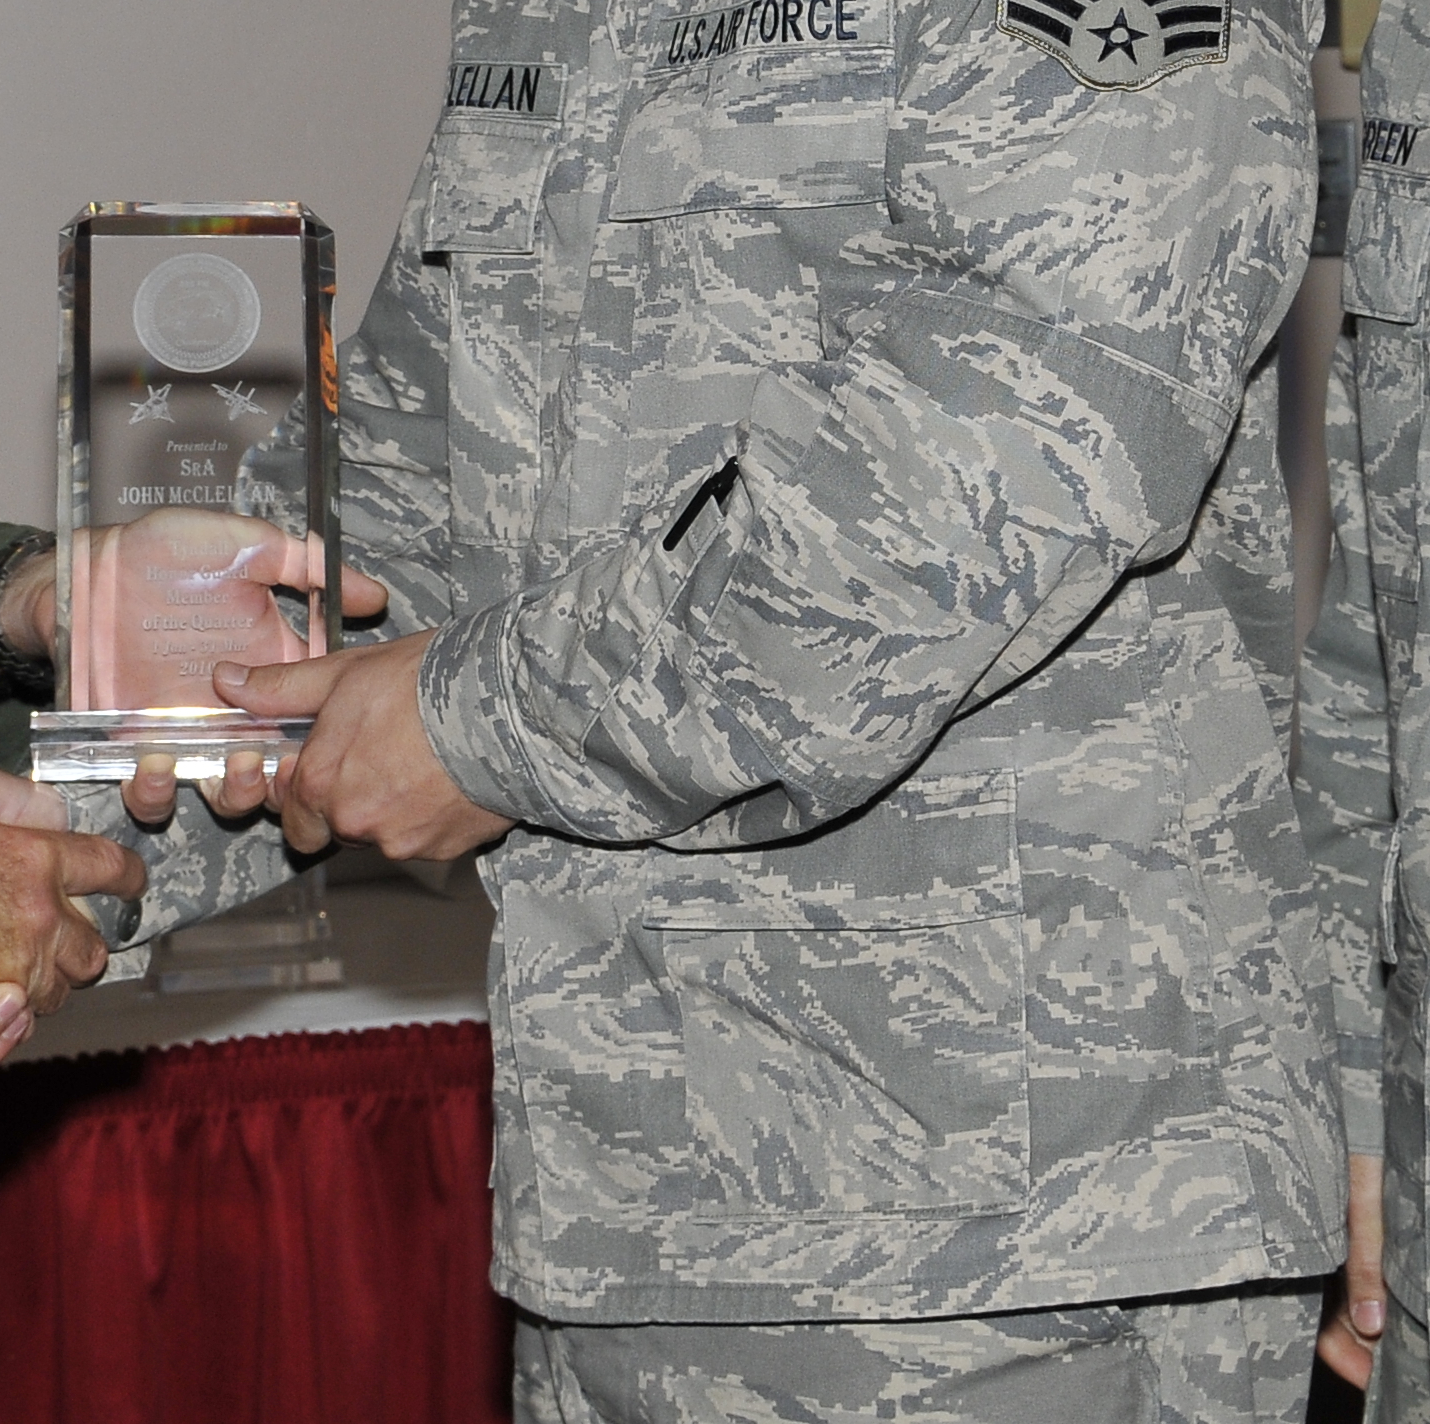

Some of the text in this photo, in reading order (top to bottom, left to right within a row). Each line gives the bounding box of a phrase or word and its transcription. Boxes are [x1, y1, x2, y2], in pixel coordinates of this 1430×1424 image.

[704, 6, 745, 59] AIR
[447, 65, 541, 113] LELLAN
[1362, 120, 1419, 166] REEN
[166, 439, 229, 453] Presented to
[118, 485, 165, 505] JOHN
[166, 589, 230, 605] Member
[142, 613, 254, 632] of the Quarter
[179, 660, 216, 678] 2010
